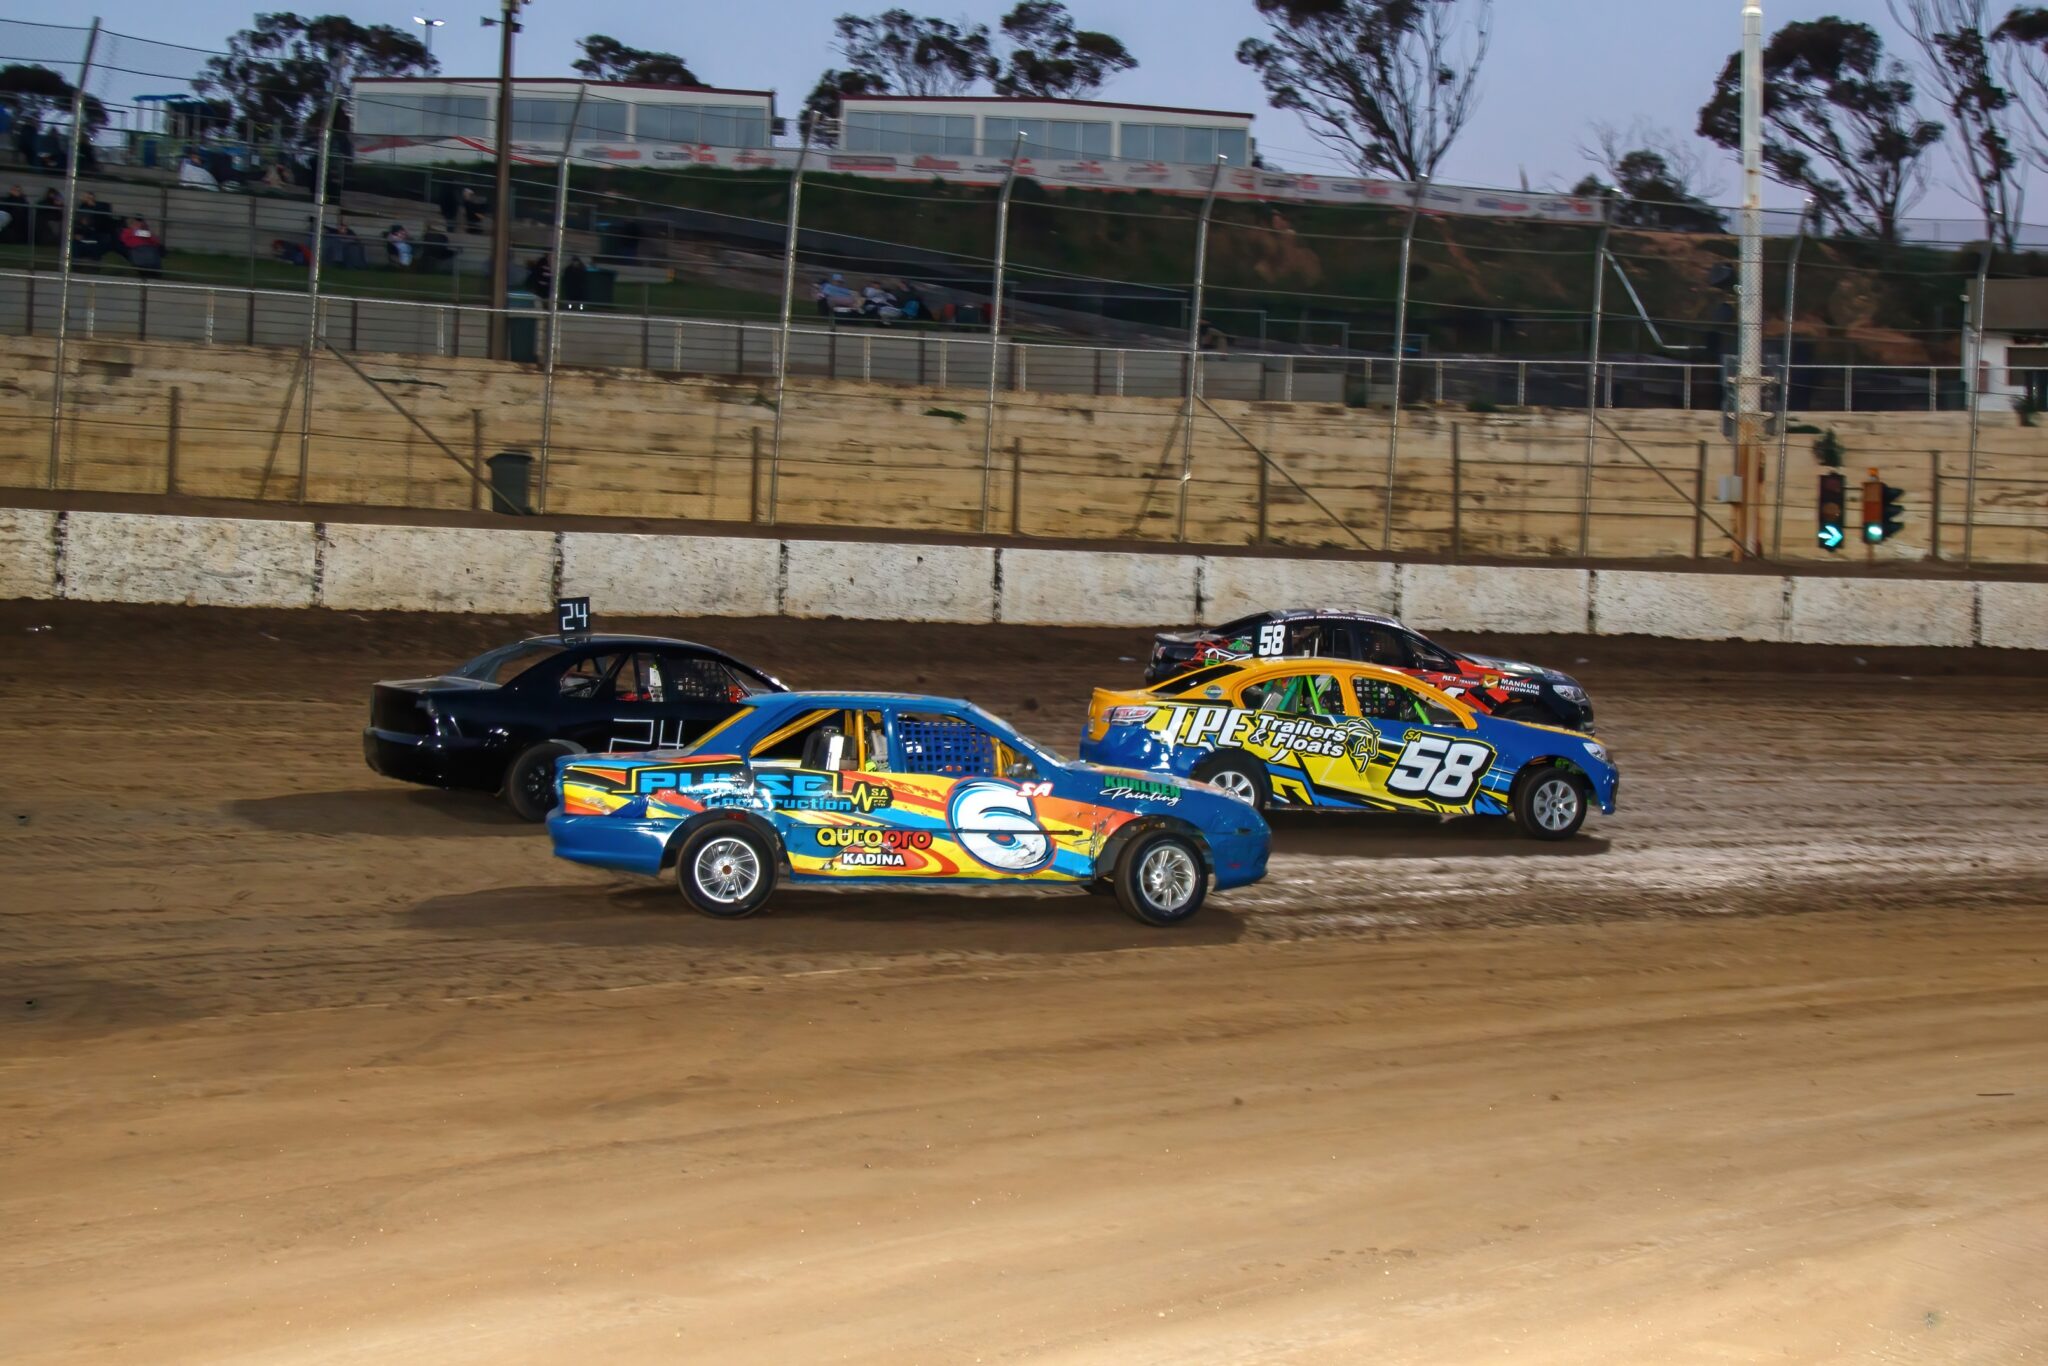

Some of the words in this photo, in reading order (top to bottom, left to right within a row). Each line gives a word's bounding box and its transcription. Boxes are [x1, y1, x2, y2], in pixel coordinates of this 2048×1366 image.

[560, 603, 588, 630] 24
[1258, 624, 1286, 656] 58
[1499, 685, 1540, 696] HARDWARE
[1500, 678, 1540, 691] MANNUM
[609, 717, 685, 752] 24
[1165, 705, 1255, 747] TPE
[1258, 714, 1346, 742] Trailers
[1405, 731, 1422, 742] SA
[1250, 728, 1269, 745] &
[1272, 732, 1344, 757] Floats
[1387, 736, 1491, 798] 58
[871, 788, 888, 796] SA
[1016, 782, 1054, 796] SA
[1099, 786, 1182, 806] Painting
[948, 778, 1052, 872] 6
[843, 853, 904, 866] KADINA
